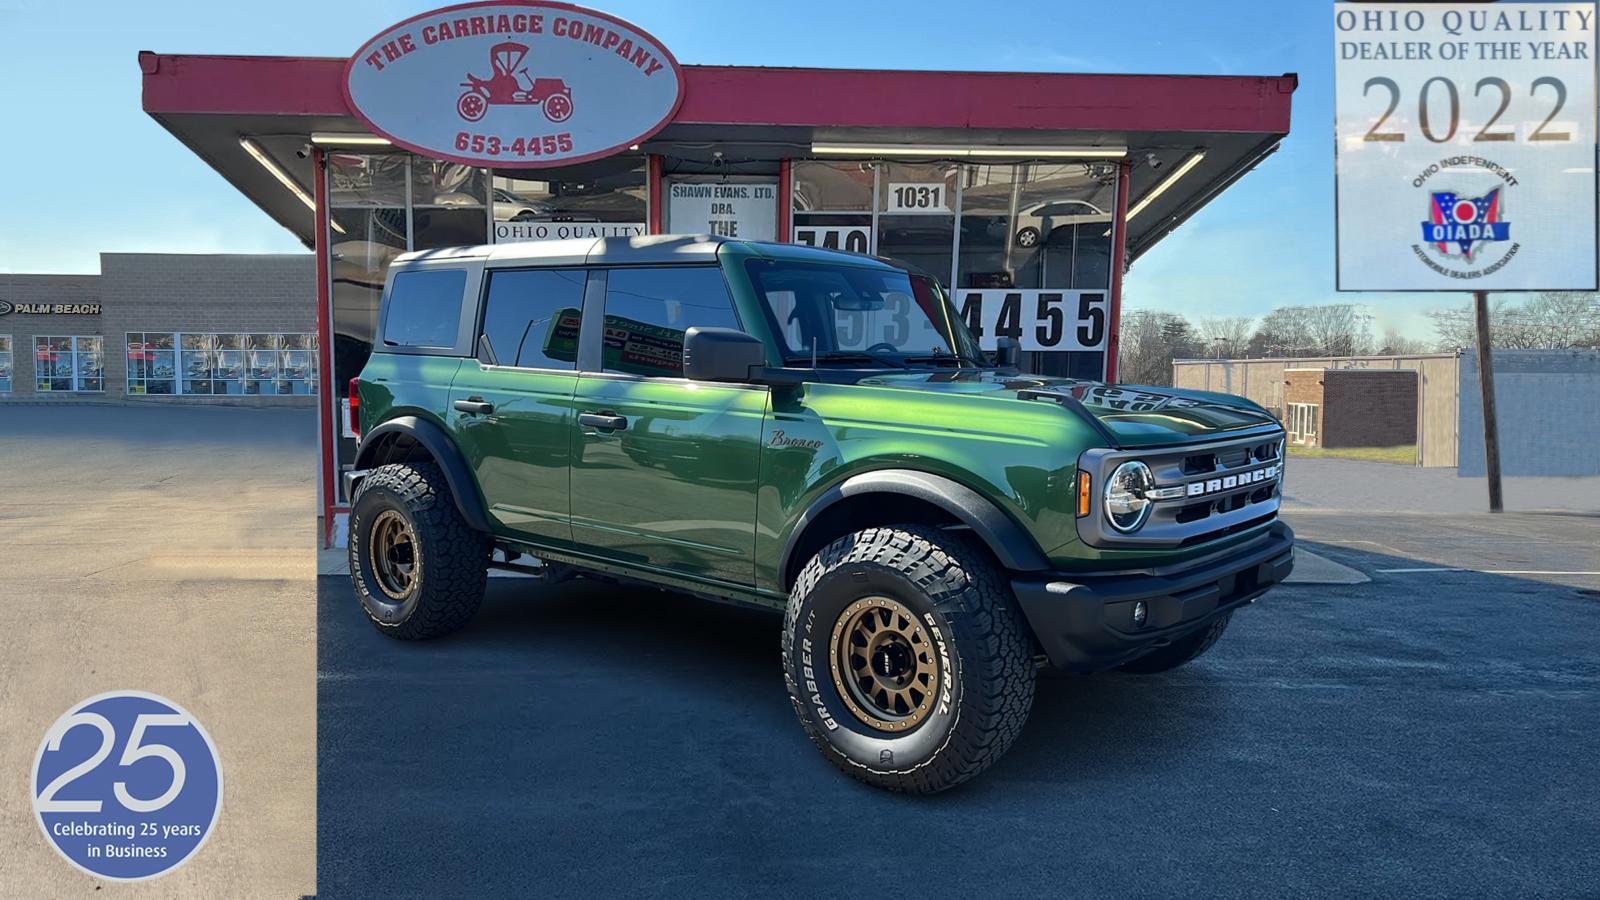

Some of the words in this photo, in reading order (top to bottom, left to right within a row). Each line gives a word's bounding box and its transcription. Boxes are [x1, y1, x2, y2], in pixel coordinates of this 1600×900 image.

[1337, 10, 1425, 31] OHIO
[1442, 10, 1592, 35] QUALITY
[366, 33, 416, 71] THE
[422, 14, 544, 45] CARRIAGE
[553, 17, 664, 77] COMPANY
[1340, 42, 1433, 60] DEALER
[1438, 42, 1469, 60] OF
[1475, 42, 1522, 60] THE
[1528, 42, 1589, 60] YEAR
[1362, 76, 1571, 144] 2022
[455, 132, 573, 156] 653-4455
[1412, 164, 1439, 188] OHIO
[1440, 156, 1519, 187] INDEPENDENT
[672, 185, 712, 199] SHAWN
[894, 186, 940, 208] 1031
[711, 203, 735, 215] DBA.
[496, 225, 548, 239] OHIO
[558, 225, 644, 240] QUALITY
[708, 220, 737, 237] THE
[1432, 224, 1495, 240] OIADA
[1411, 244, 1449, 277] AUTOMOBILE
[1449, 269, 1482, 279] DEALERS
[1483, 242, 1521, 276] ASSOCIATION
[15, 304, 50, 314] PALM
[54, 304, 100, 314] BEACH
[770, 427, 824, 448] Bronco
[1187, 466, 1279, 496] BRONCO
[352, 533, 370, 597] GRABBER
[804, 609, 816, 634] A/T
[923, 613, 952, 716] GENERAL
[802, 638, 839, 731] GRABBER
